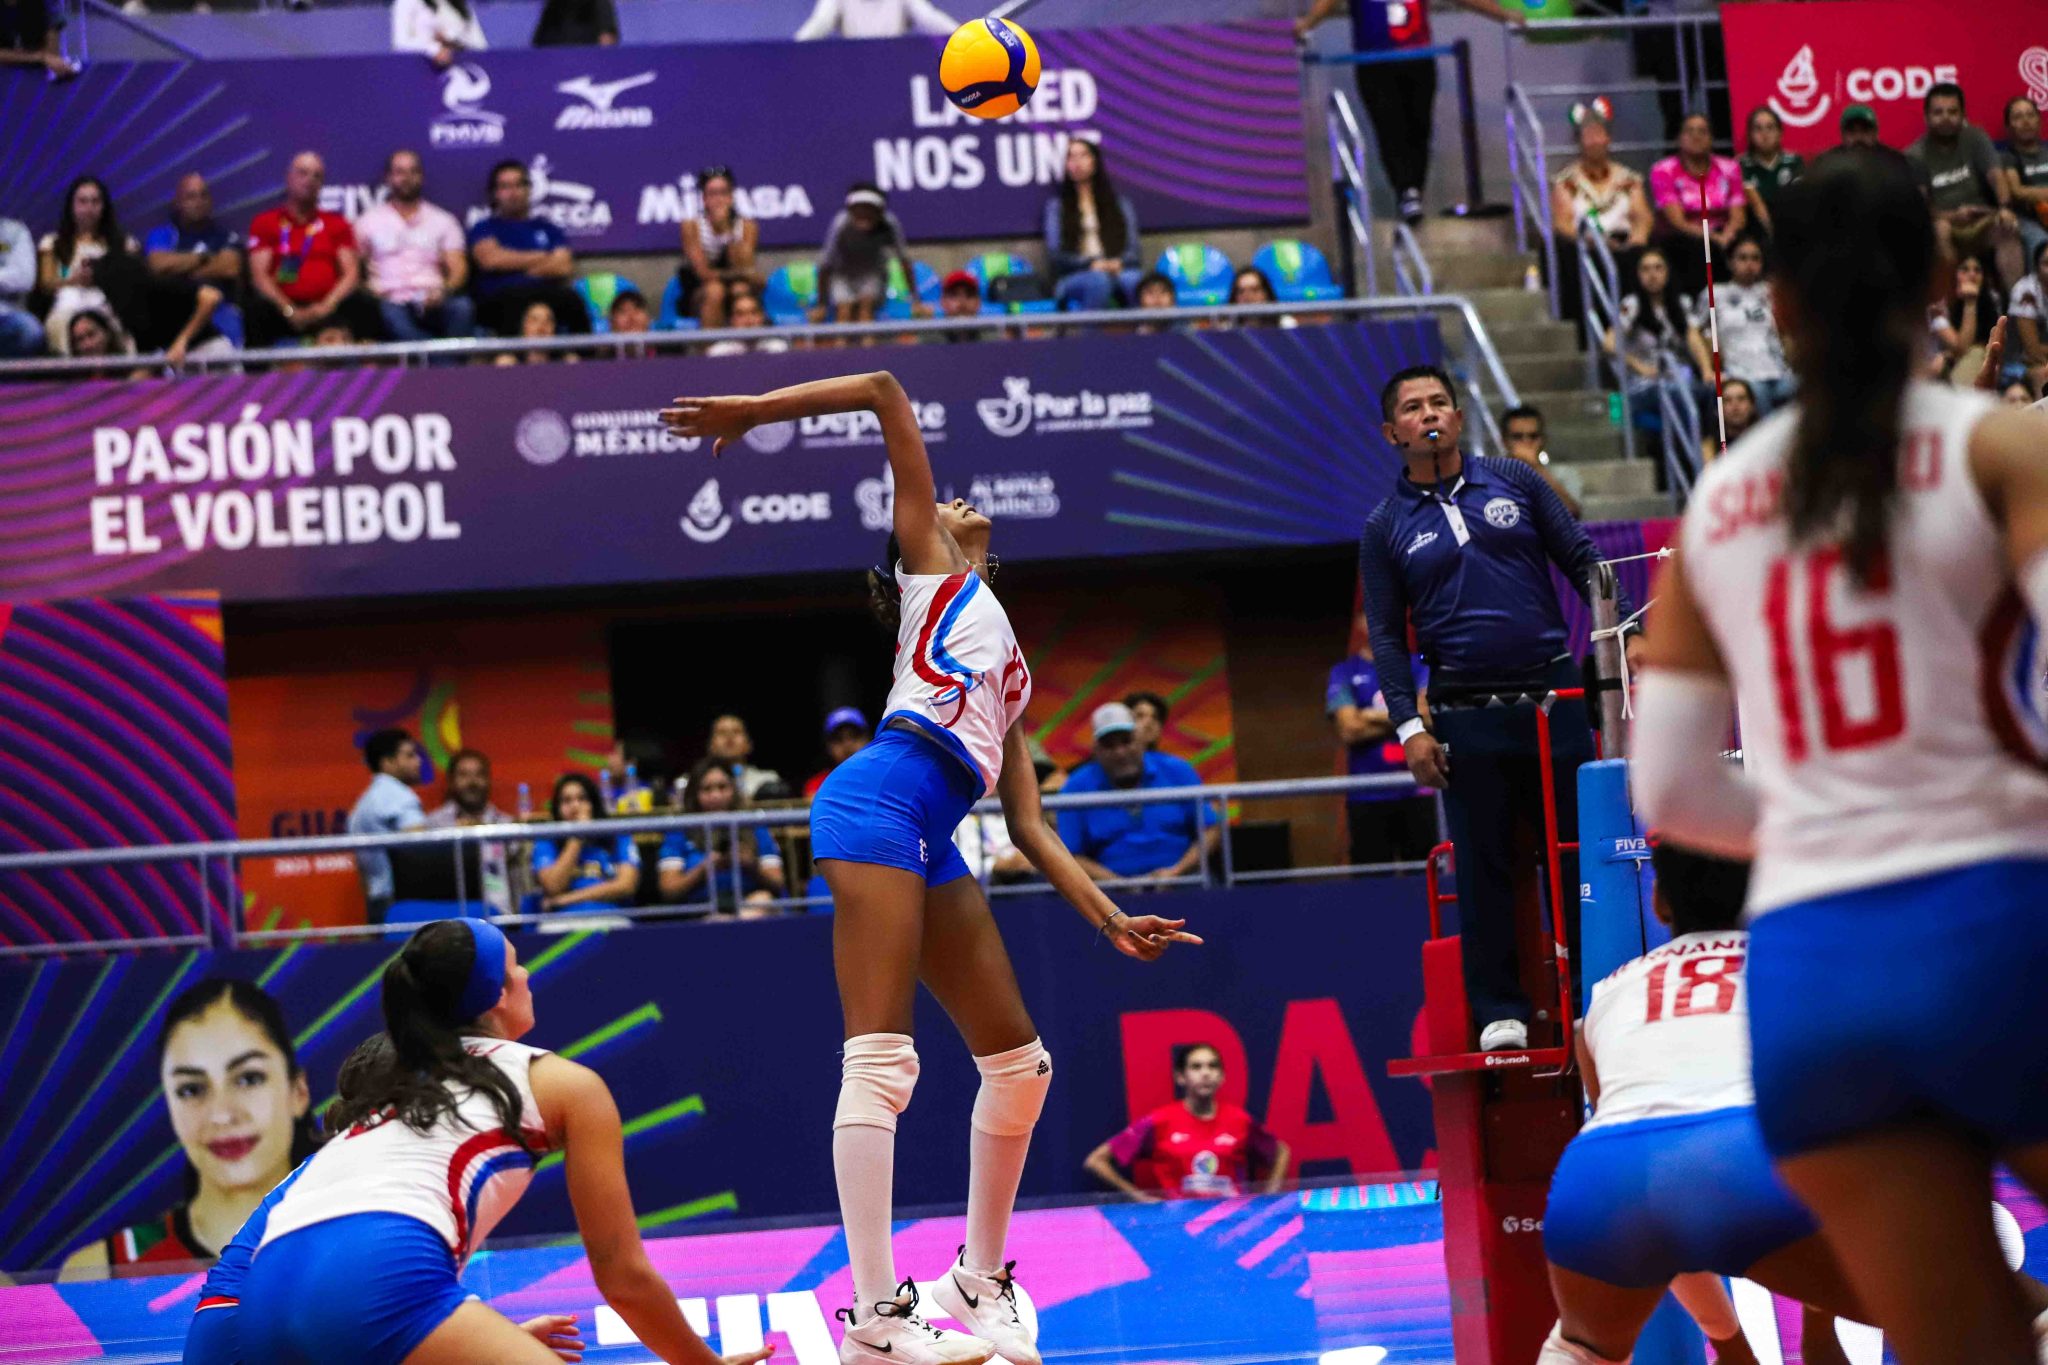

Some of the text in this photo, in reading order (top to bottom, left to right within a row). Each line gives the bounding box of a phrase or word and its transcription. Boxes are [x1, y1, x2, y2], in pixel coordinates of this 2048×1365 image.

[873, 132, 1101, 192] NOS UN
[94, 404, 456, 486] PASIÓN POR
[91, 483, 461, 555] EL VOLEIBOL
[741, 492, 833, 524] CODE
[1764, 545, 1907, 763] 16
[1645, 954, 1747, 1024] 18
